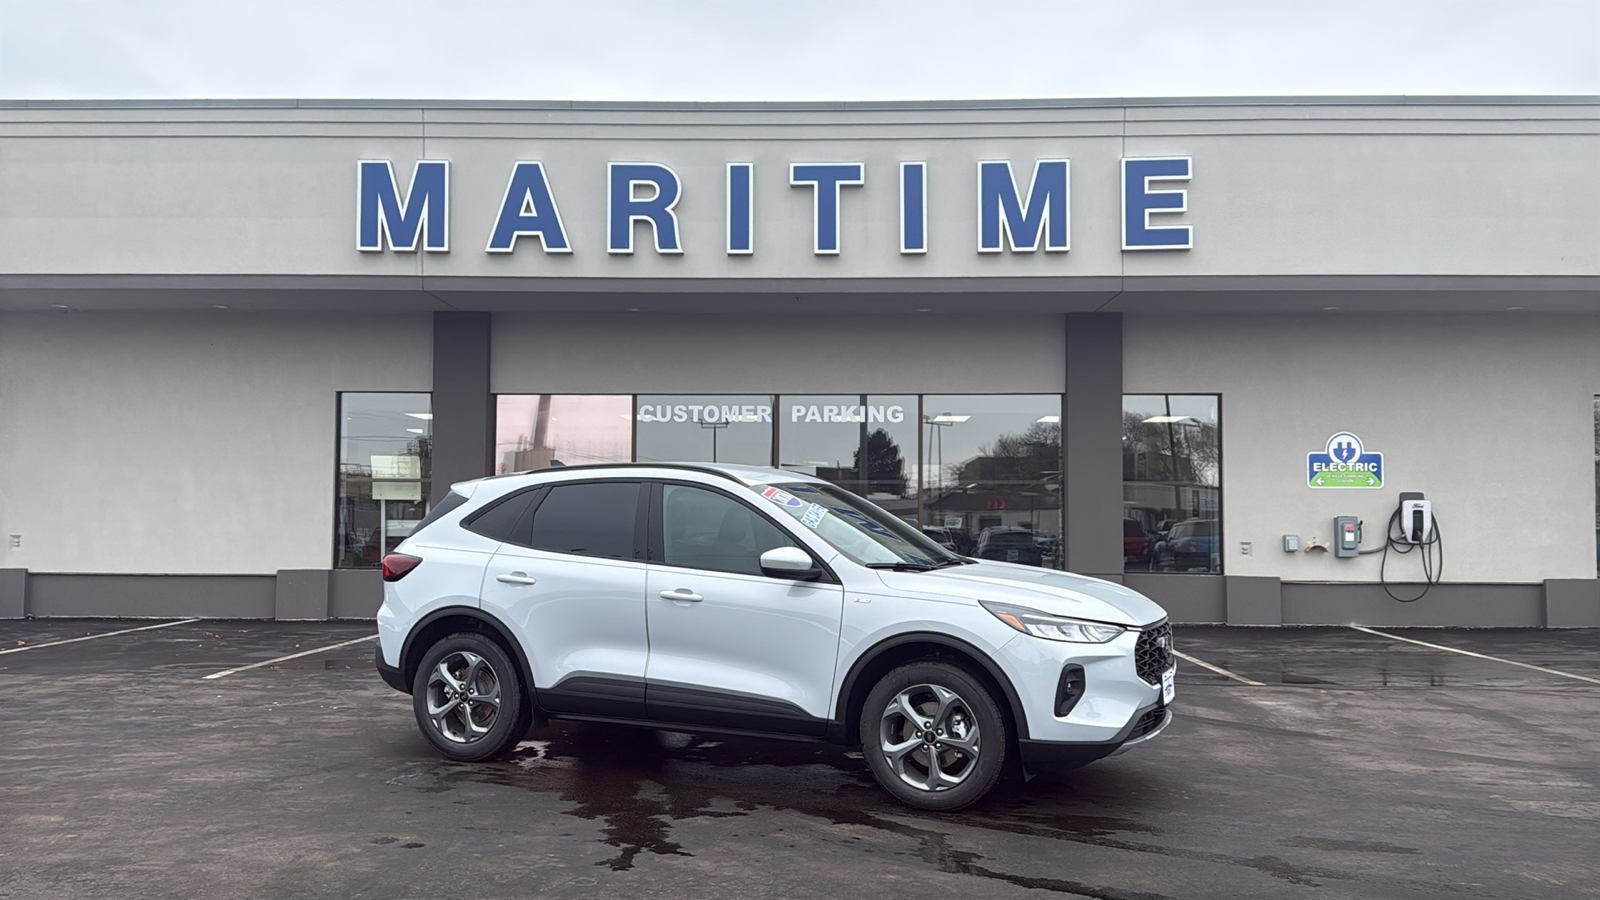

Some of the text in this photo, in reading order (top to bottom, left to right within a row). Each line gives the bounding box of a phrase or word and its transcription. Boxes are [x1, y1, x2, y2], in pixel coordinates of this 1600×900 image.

[357, 155, 1193, 255] MARITIME
[639, 404, 904, 423] CUSTOMER PARKING
[1313, 462, 1378, 472] ELECTRIC
